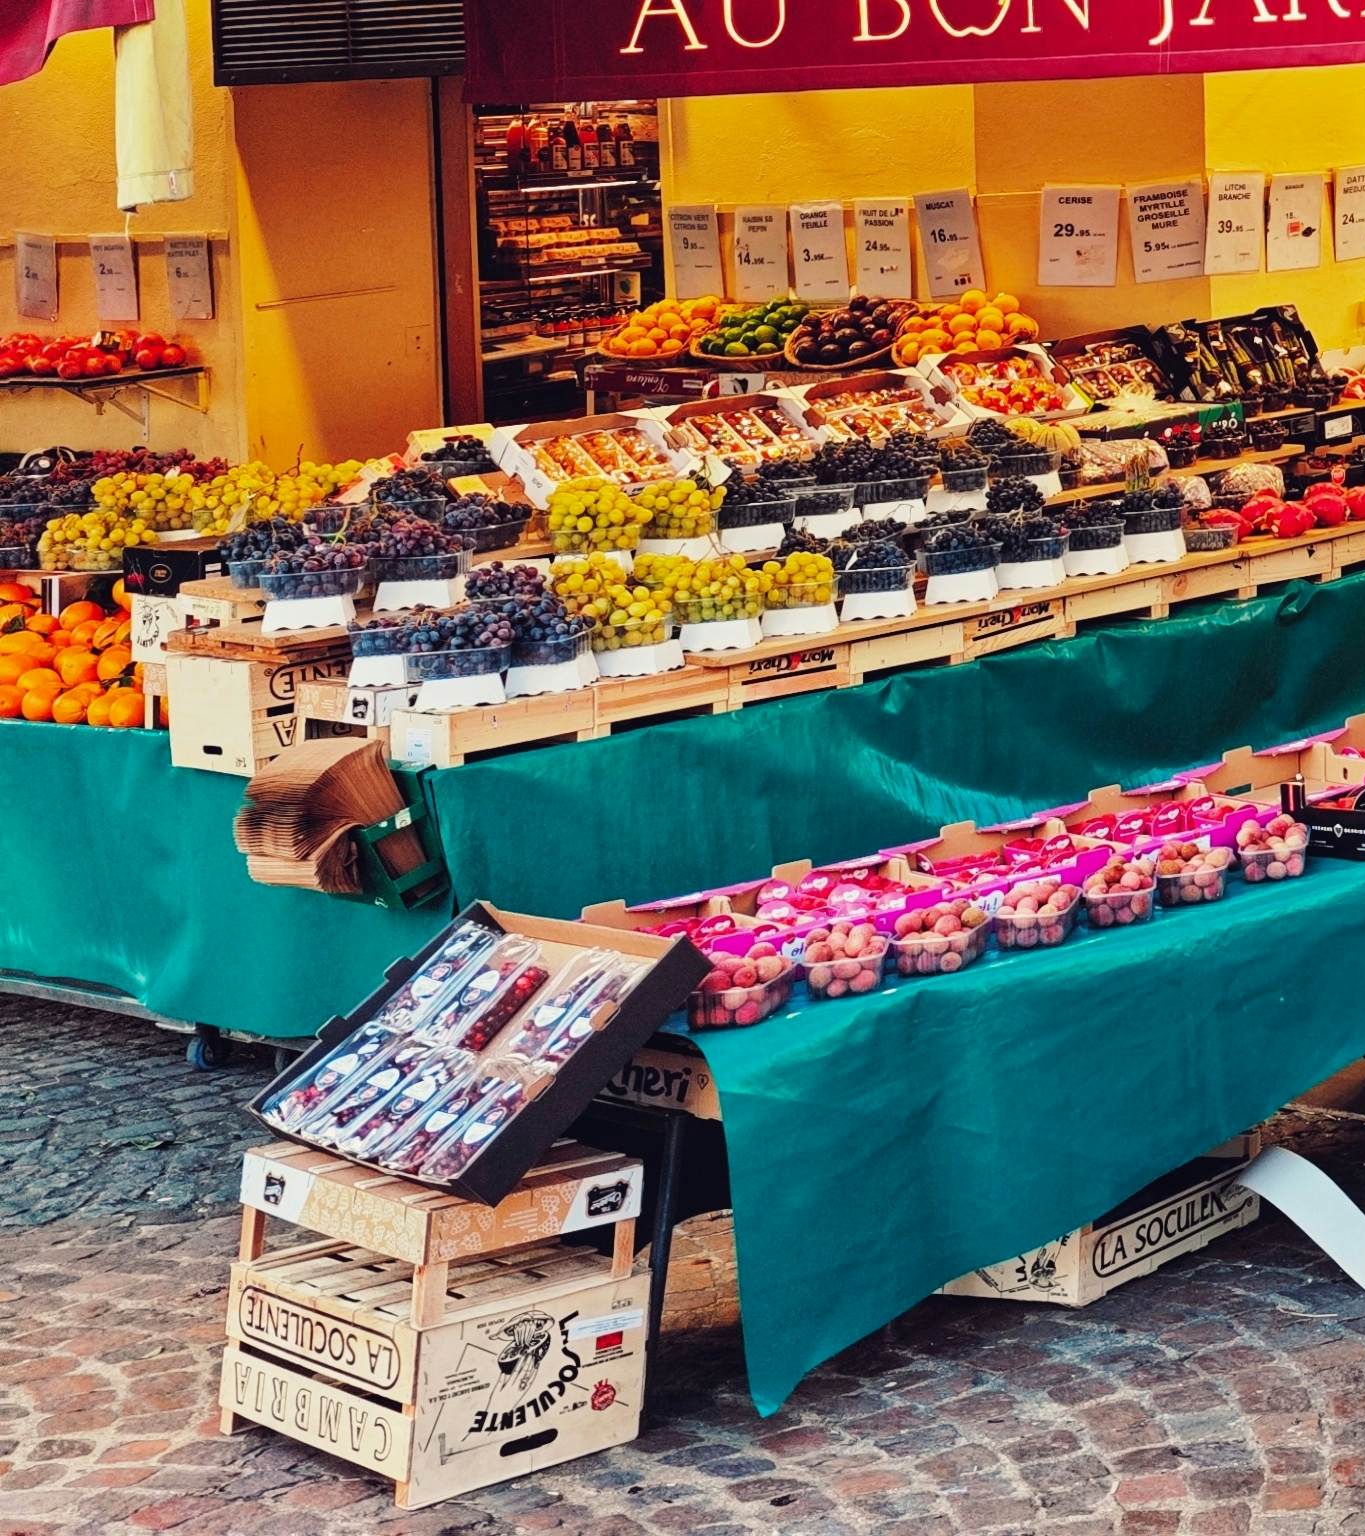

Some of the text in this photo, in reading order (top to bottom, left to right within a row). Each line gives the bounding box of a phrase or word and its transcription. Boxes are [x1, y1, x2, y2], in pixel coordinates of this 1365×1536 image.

[1224, 183, 1246, 192] LITCHI
[1058, 196, 1093, 205] CERISE
[1133, 189, 1189, 204] FRAMBOISE
[1218, 192, 1252, 201] BRANCHE
[925, 200, 954, 211] MUSCAT
[1139, 199, 1185, 213] MYRTILLE
[1137, 208, 1191, 223] GROSEILLE
[864, 219, 894, 227] PASSION
[1151, 219, 1179, 230] MURE
[1217, 219, 1244, 233] 39.95
[1053, 223, 1091, 238] 29.95
[1100, 1236, 1128, 1270] LA
[245, 1293, 399, 1380] LA SOCULENTE
[233, 1360, 393, 1462] CAMBRIA
